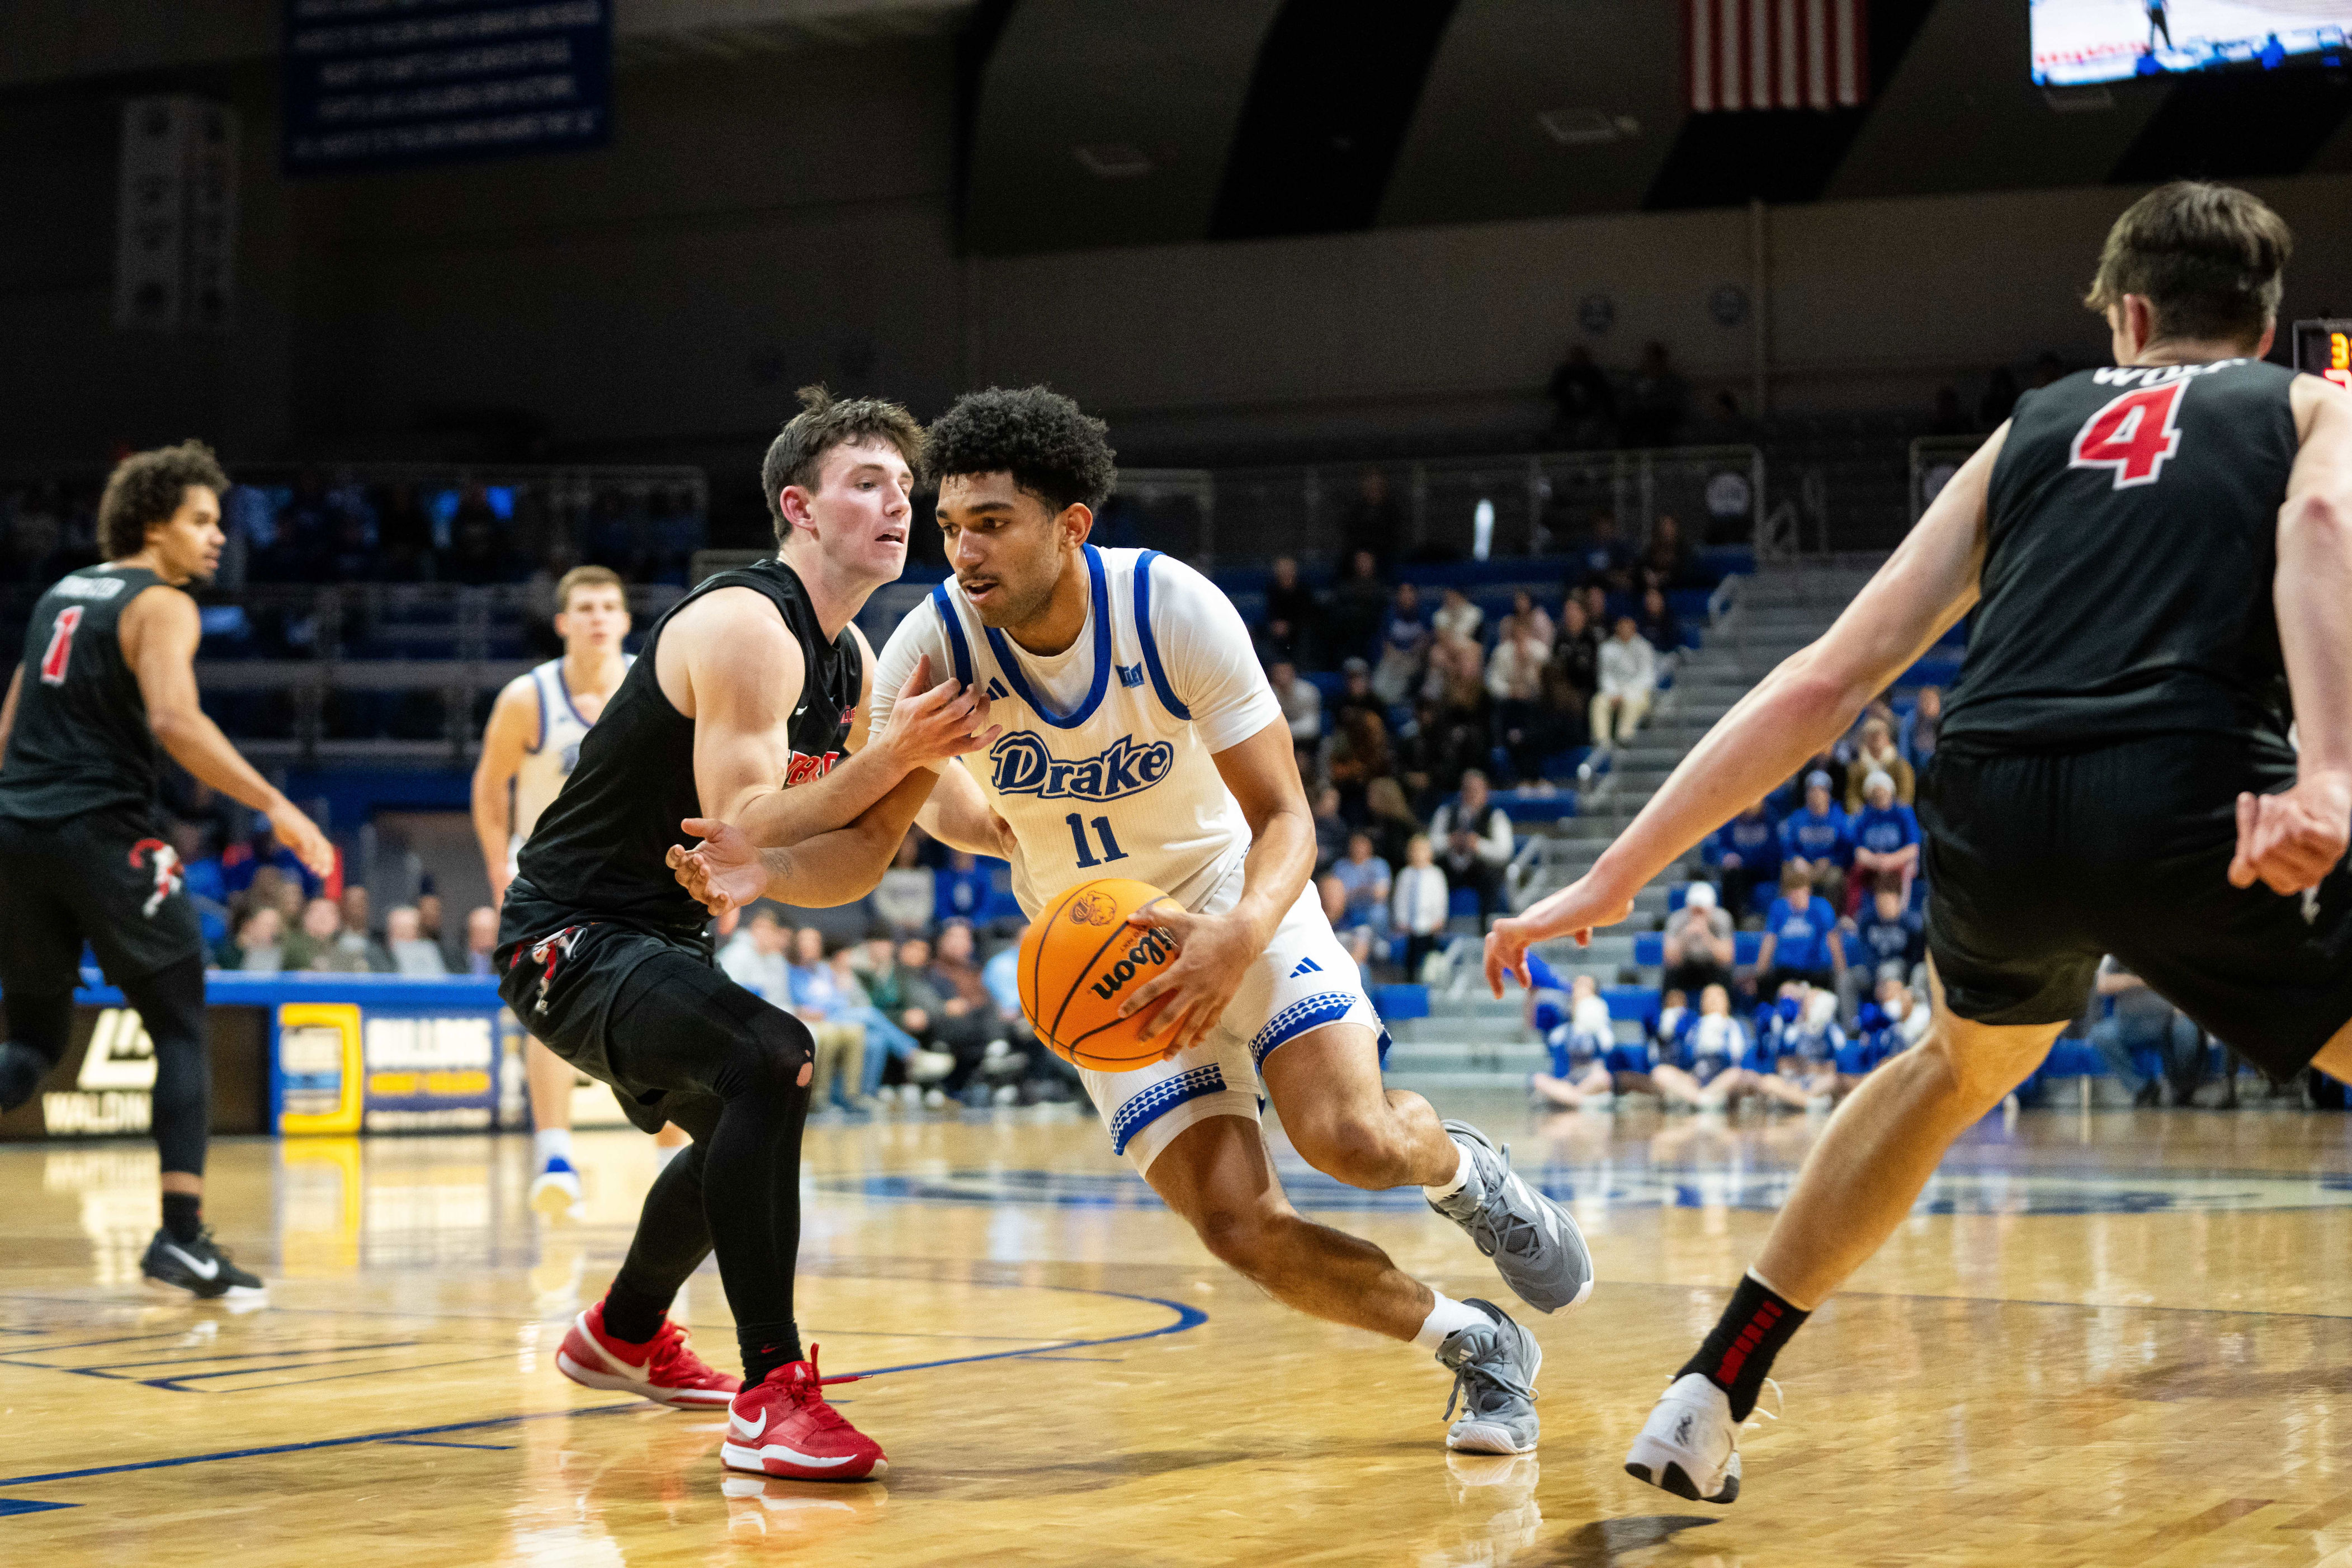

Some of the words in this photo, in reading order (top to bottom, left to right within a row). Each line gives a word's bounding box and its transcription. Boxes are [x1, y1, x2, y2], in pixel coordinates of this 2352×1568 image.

[2331, 333, 2352, 369] 3
[2070, 378, 2191, 490] 4
[40, 605, 85, 687] 1
[990, 730, 1174, 802] Drake
[1066, 813, 1129, 868] 11
[1091, 927, 1173, 1000] ilson
[42, 1092, 153, 1135] WALDIN
